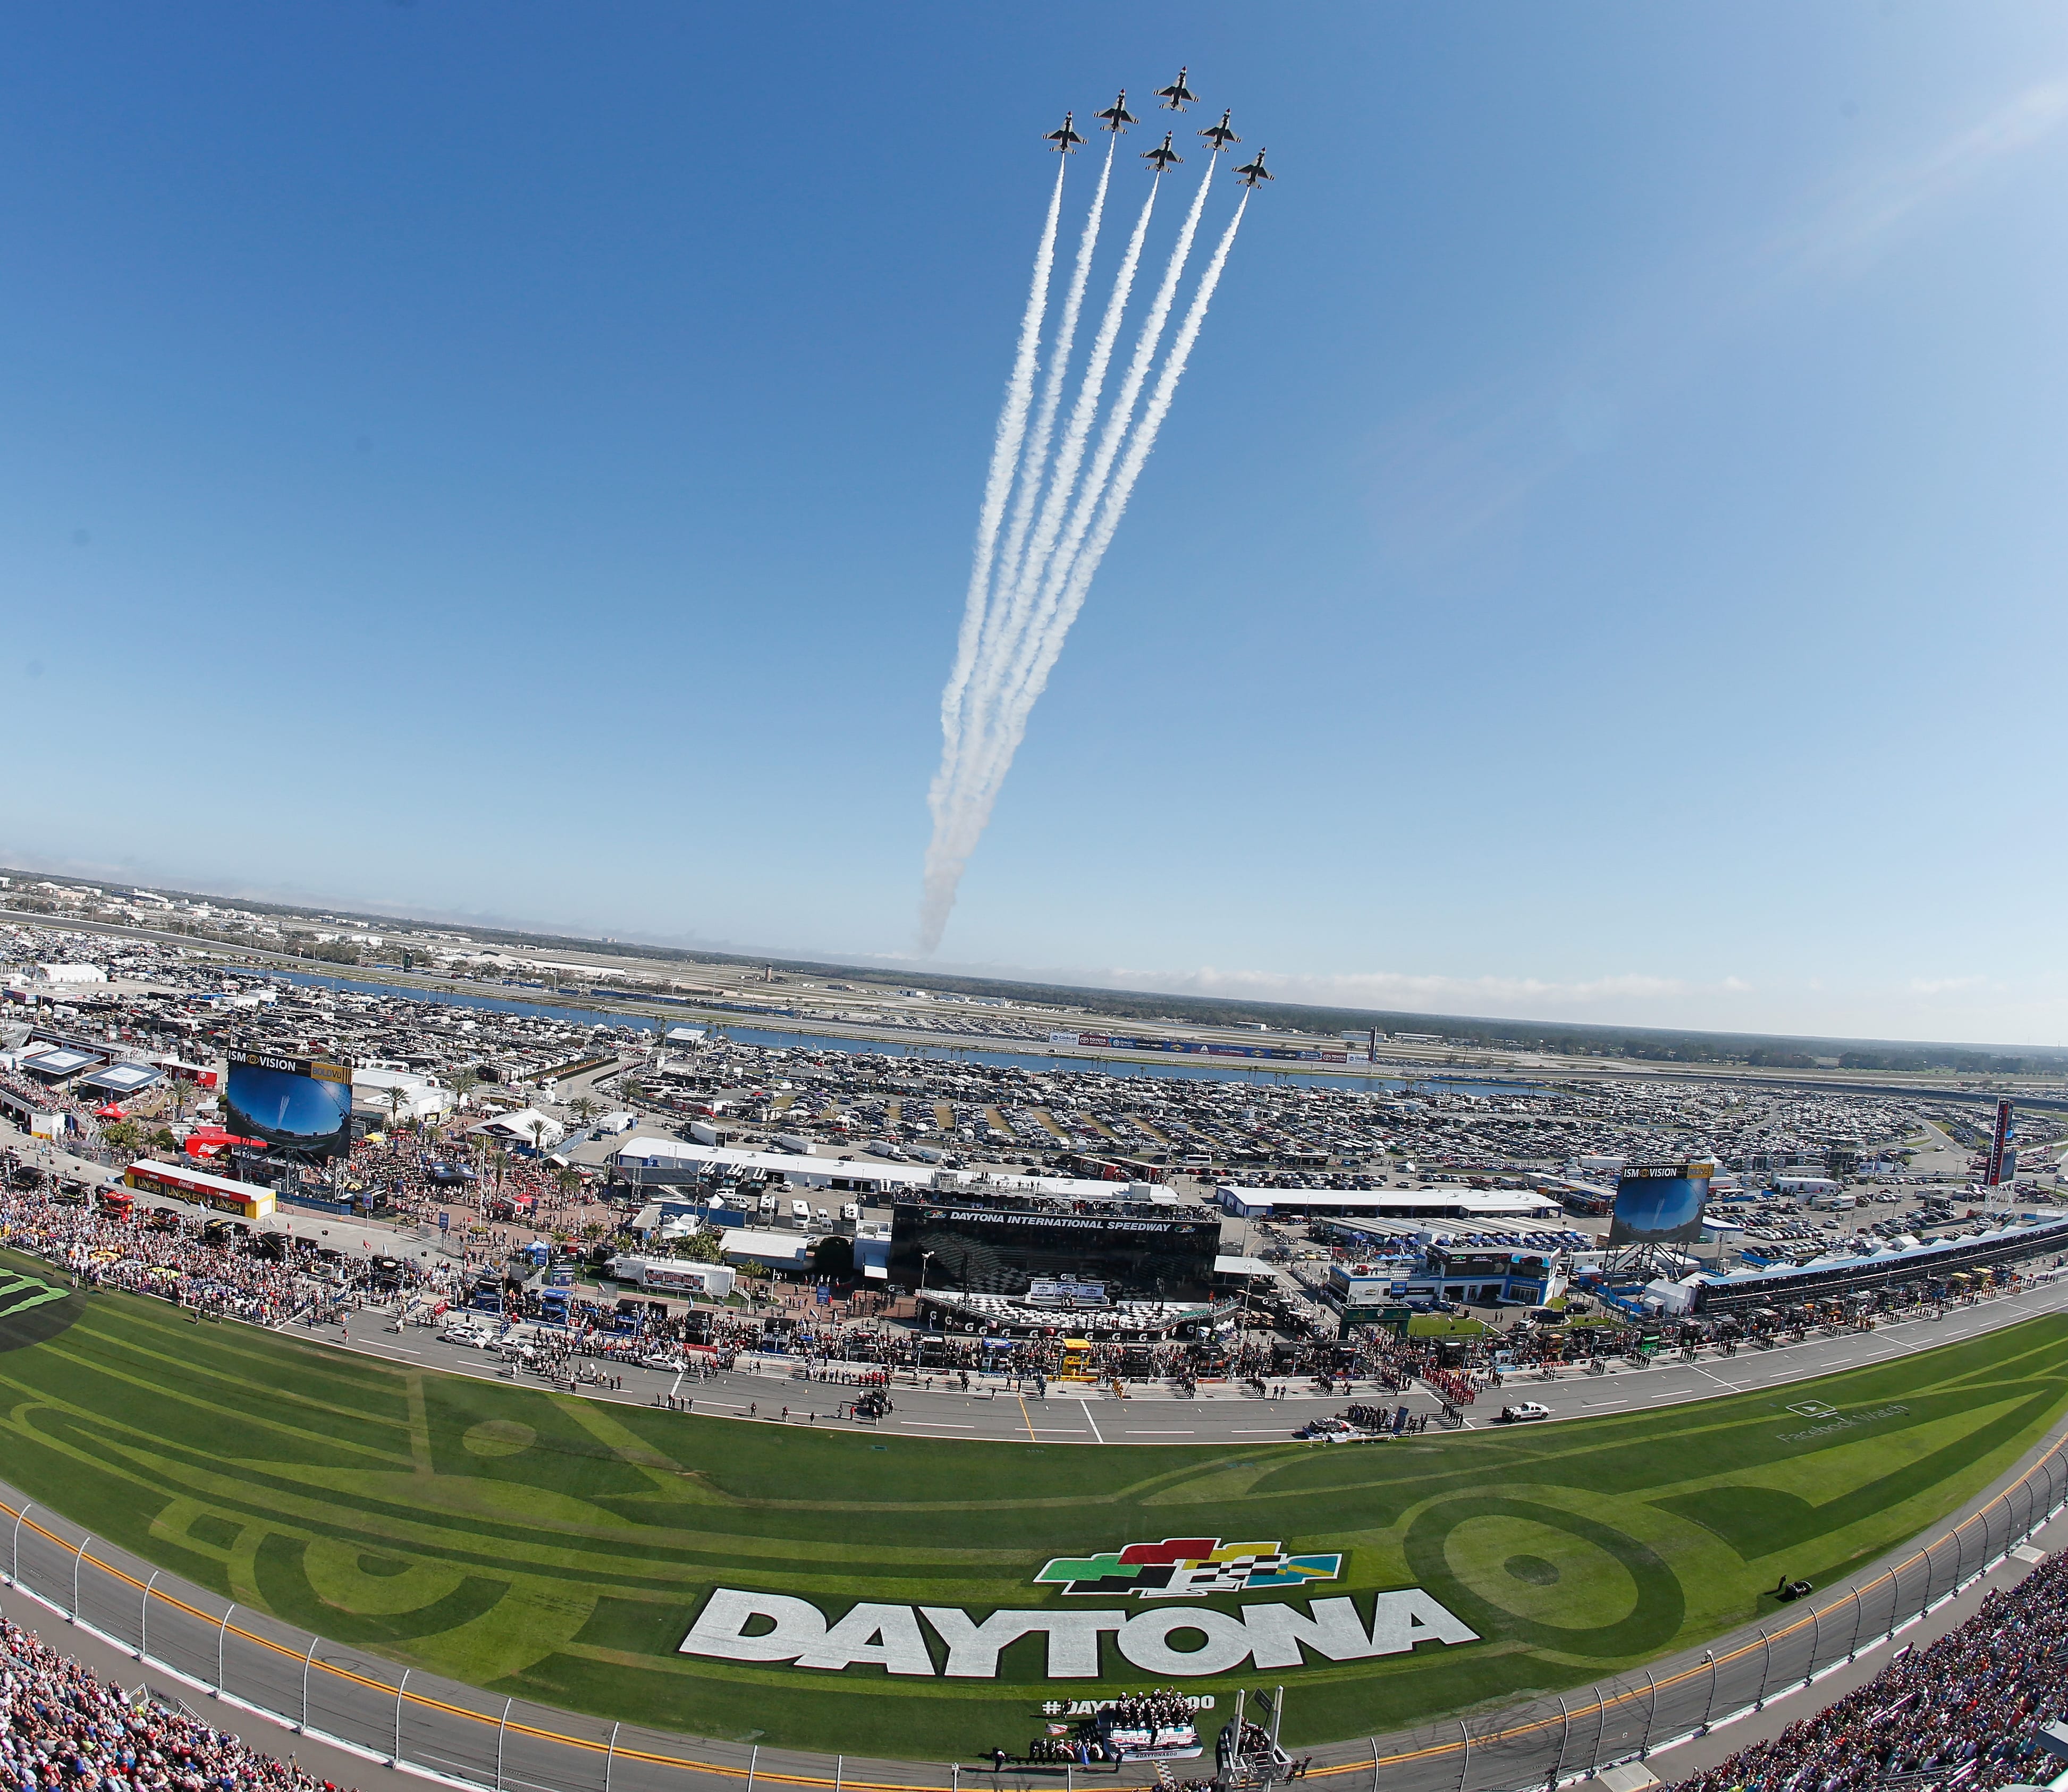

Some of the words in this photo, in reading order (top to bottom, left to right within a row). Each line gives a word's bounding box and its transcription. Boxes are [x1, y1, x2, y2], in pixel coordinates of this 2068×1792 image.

[228, 1050, 246, 1062] ISM
[259, 1056, 296, 1072] VISION
[313, 1067, 342, 1079] BOLDVu
[1624, 1169, 1640, 1178] ISM
[1650, 1168, 1677, 1177] VISION
[138, 1178, 161, 1191] UNOH
[167, 1187, 209, 1205] UNOH.EDU
[216, 1198, 241, 1212] UNOH
[950, 1212, 1005, 1223] DAYTONA
[1007, 1215, 1103, 1229] INTERNATIONAL
[1107, 1222, 1171, 1232] SPEEDWAY
[930, 1311, 936, 1320] G
[945, 1316, 952, 1325] G
[965, 1323, 974, 1331] G
[978, 1326, 987, 1335] G
[1187, 1324, 1194, 1334] G
[1001, 1329, 1010, 1337] G
[1085, 1332, 1093, 1340] G
[1112, 1333, 1120, 1341] G
[1138, 1333, 1147, 1341] G
[1161, 1331, 1167, 1341] G
[1776, 1417, 1857, 1444] Facebook
[1852, 1404, 1910, 1425] Watch
[679, 1588, 1480, 1678] DAYTONA
[1042, 1695, 1215, 1714] #DAYT00
